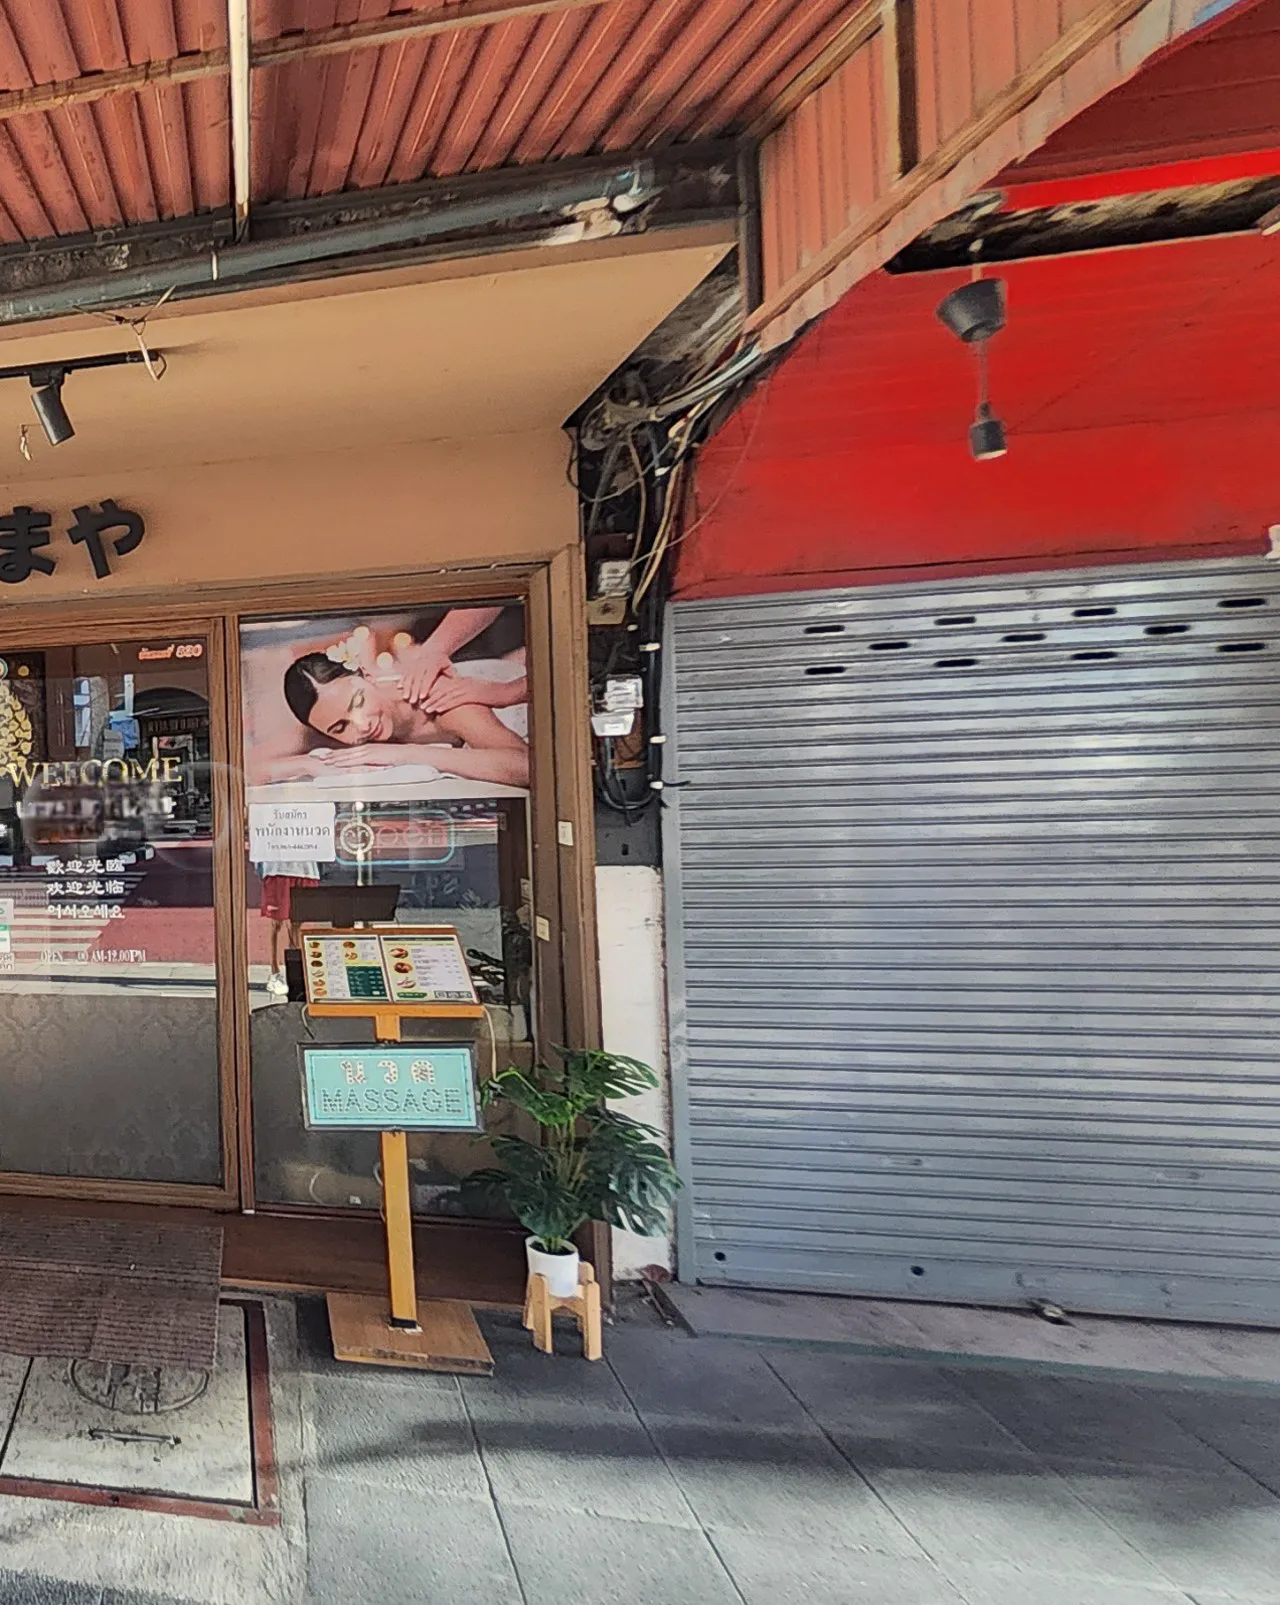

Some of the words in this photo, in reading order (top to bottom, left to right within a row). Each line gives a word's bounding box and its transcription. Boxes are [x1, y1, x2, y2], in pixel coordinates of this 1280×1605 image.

[255, 822, 331, 837] พนักงานนวด
[46, 880, 126, 896] 欢迎光临
[47, 903, 126, 919] 어서오세요
[322, 1088, 464, 1113] MASSAGE
